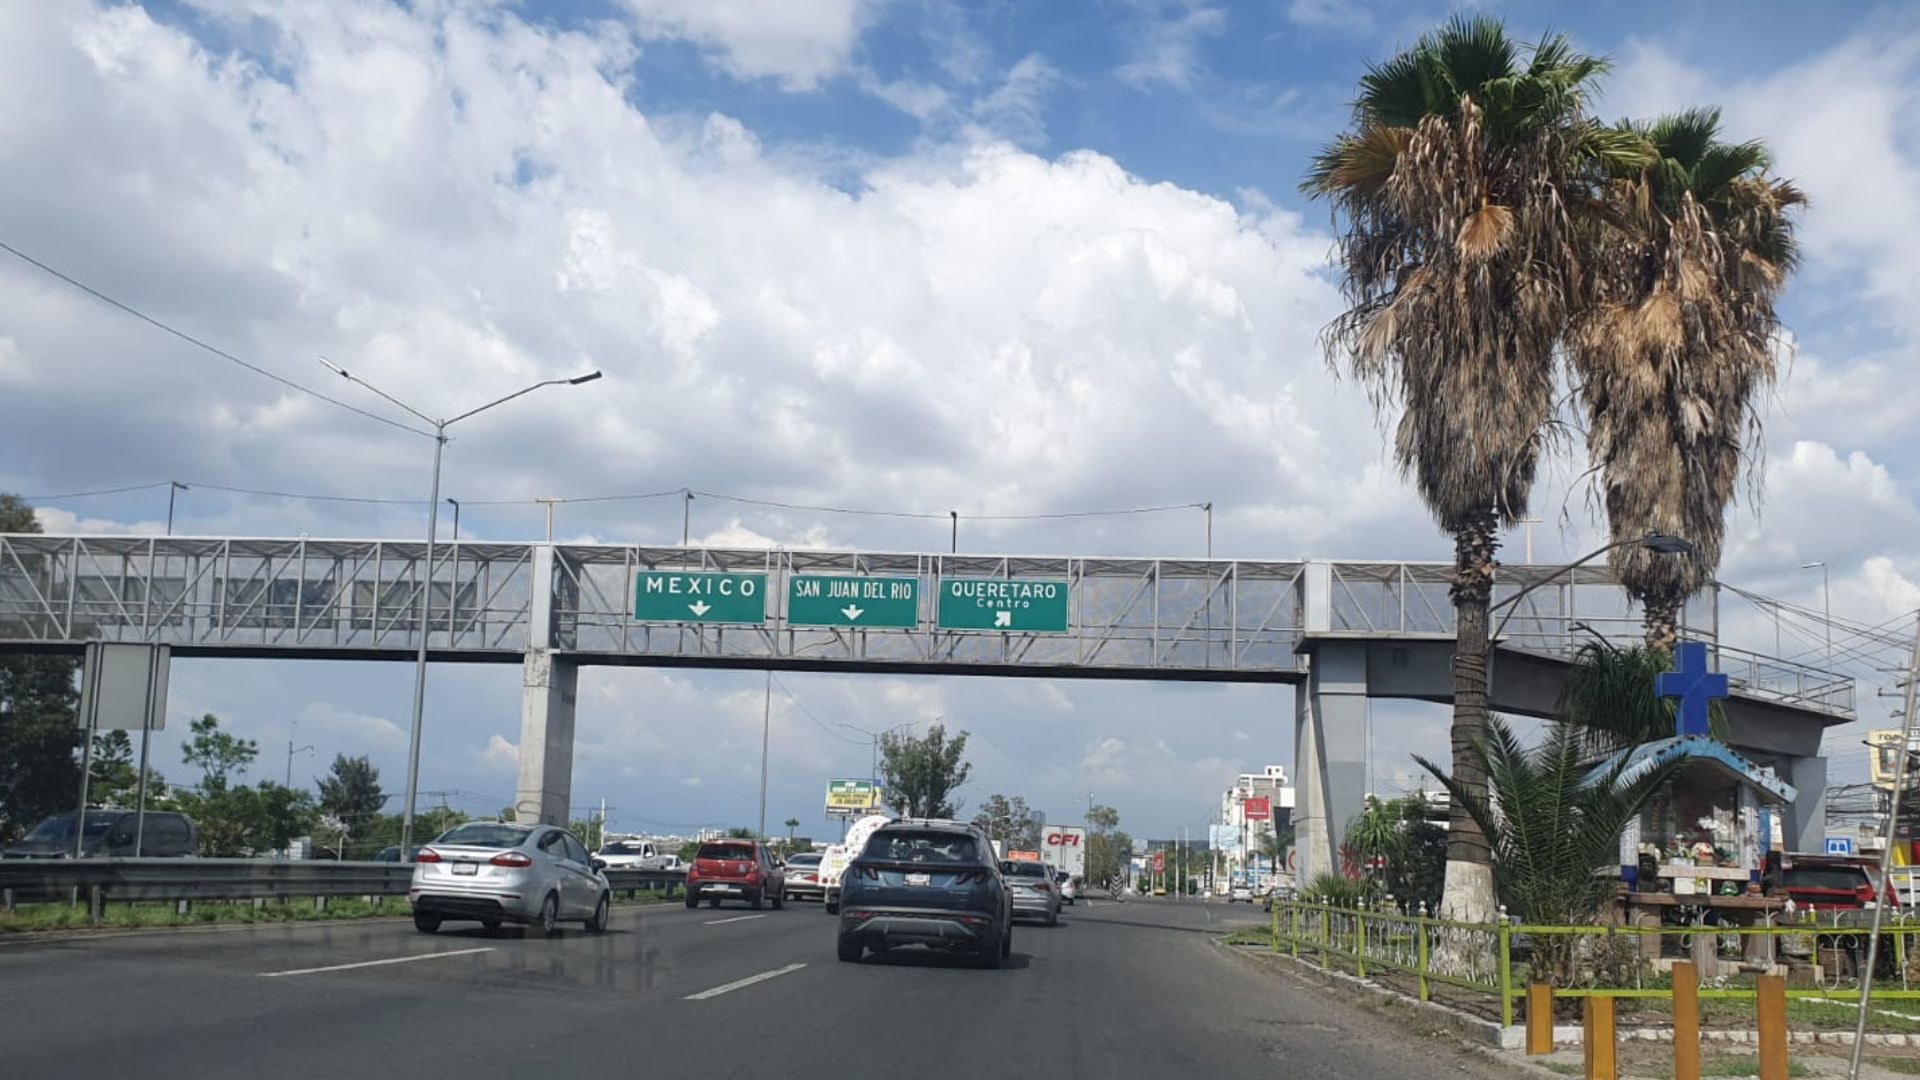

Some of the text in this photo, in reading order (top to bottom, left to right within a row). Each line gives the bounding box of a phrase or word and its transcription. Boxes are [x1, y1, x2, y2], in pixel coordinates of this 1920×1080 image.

[646, 576, 755, 596] MEXICO
[796, 579, 912, 600] SAN JUAN DEL RIO
[951, 581, 1057, 599] QUERETARO
[976, 598, 1030, 608] Centro
[1048, 834, 1079, 846] CFI
